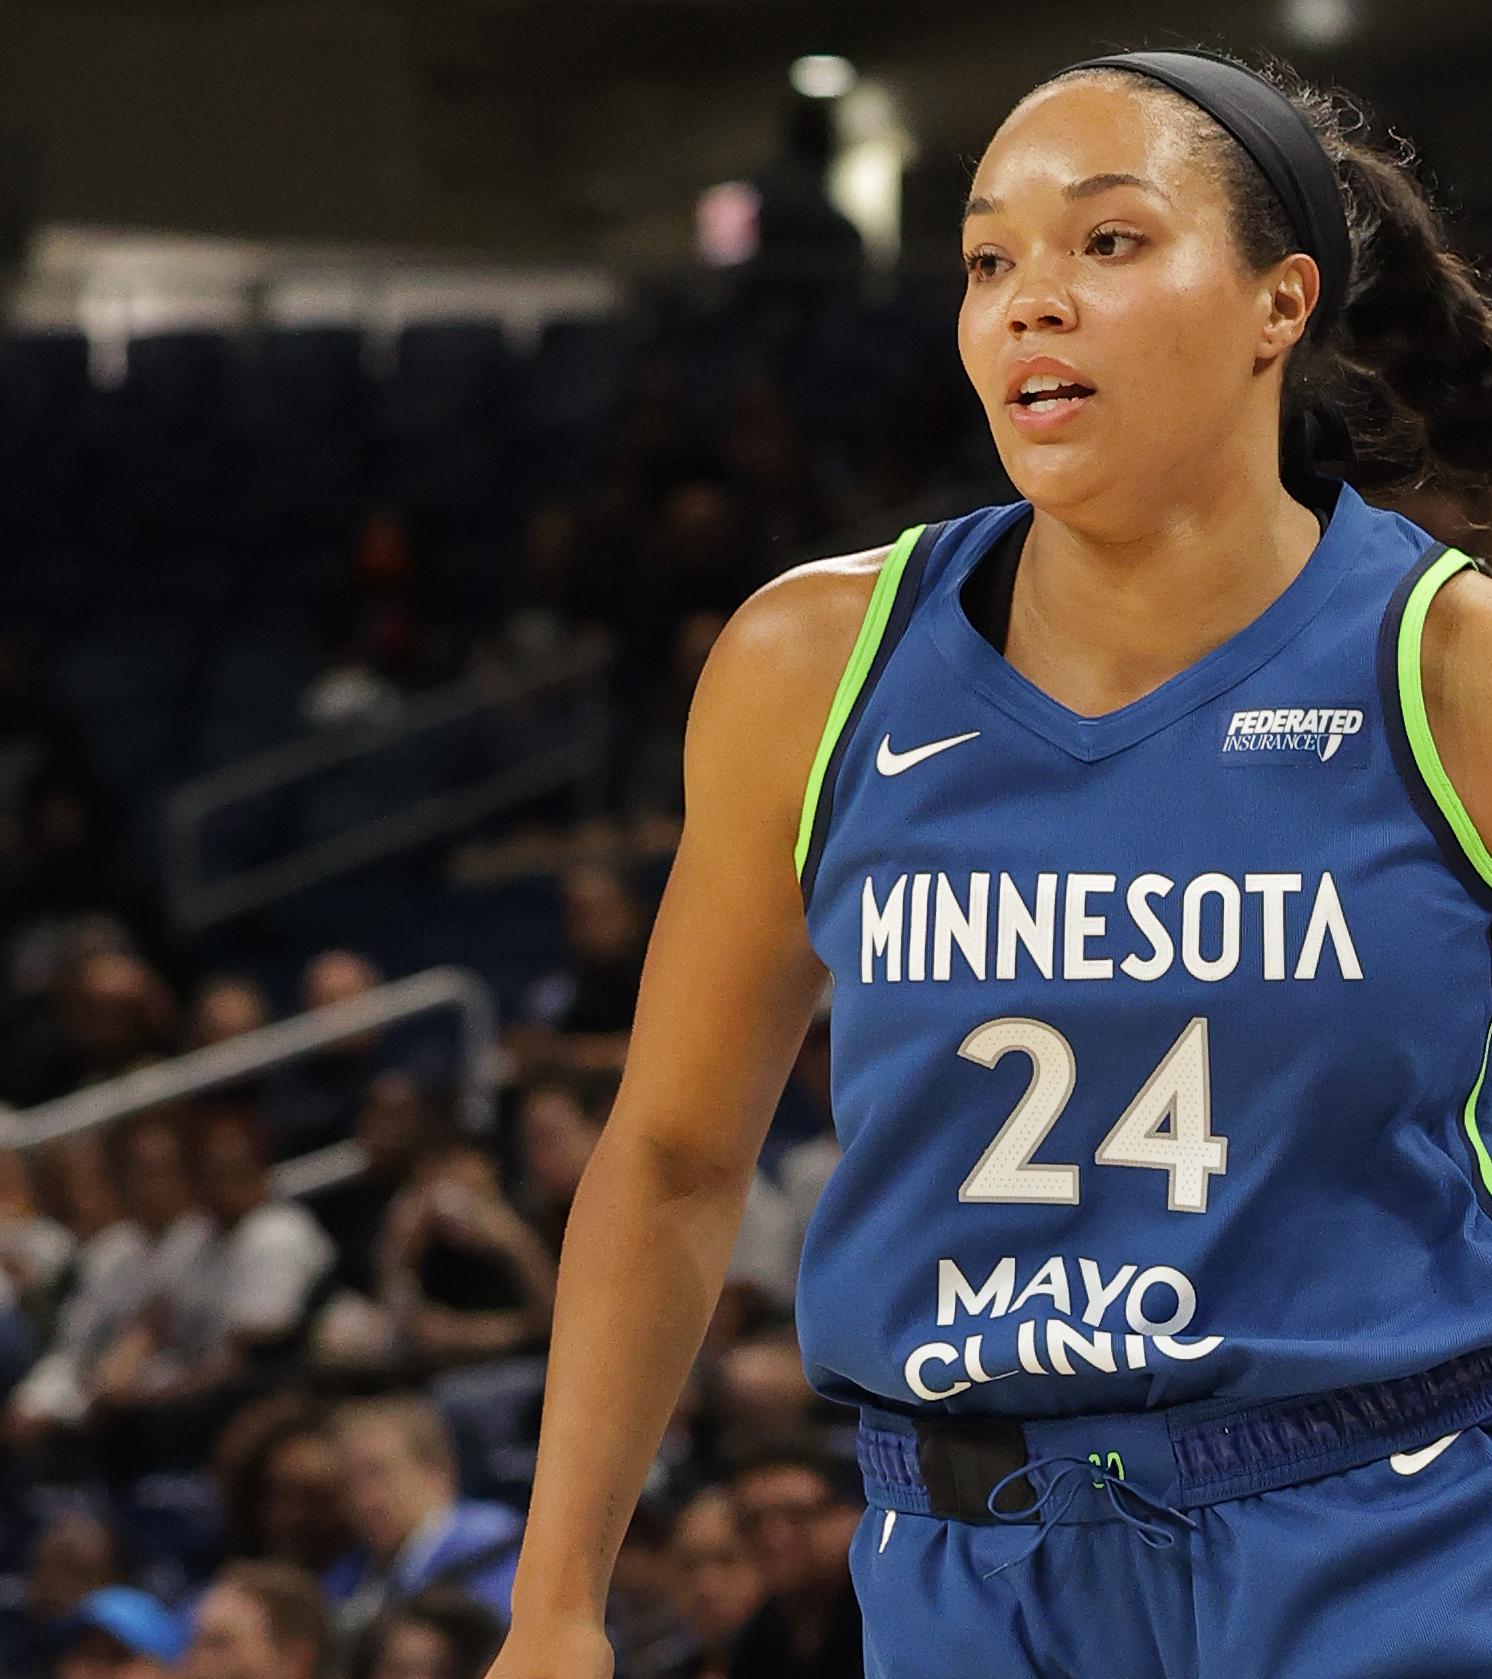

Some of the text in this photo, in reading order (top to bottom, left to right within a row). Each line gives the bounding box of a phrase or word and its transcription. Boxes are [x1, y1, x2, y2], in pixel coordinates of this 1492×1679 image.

[1222, 733, 1318, 752] INSURANCE
[1227, 708, 1364, 735] FEDERATED
[861, 871, 1364, 983] MINNESOTA
[957, 1017, 1228, 1213] 24
[936, 1256, 1196, 1336] MAYO
